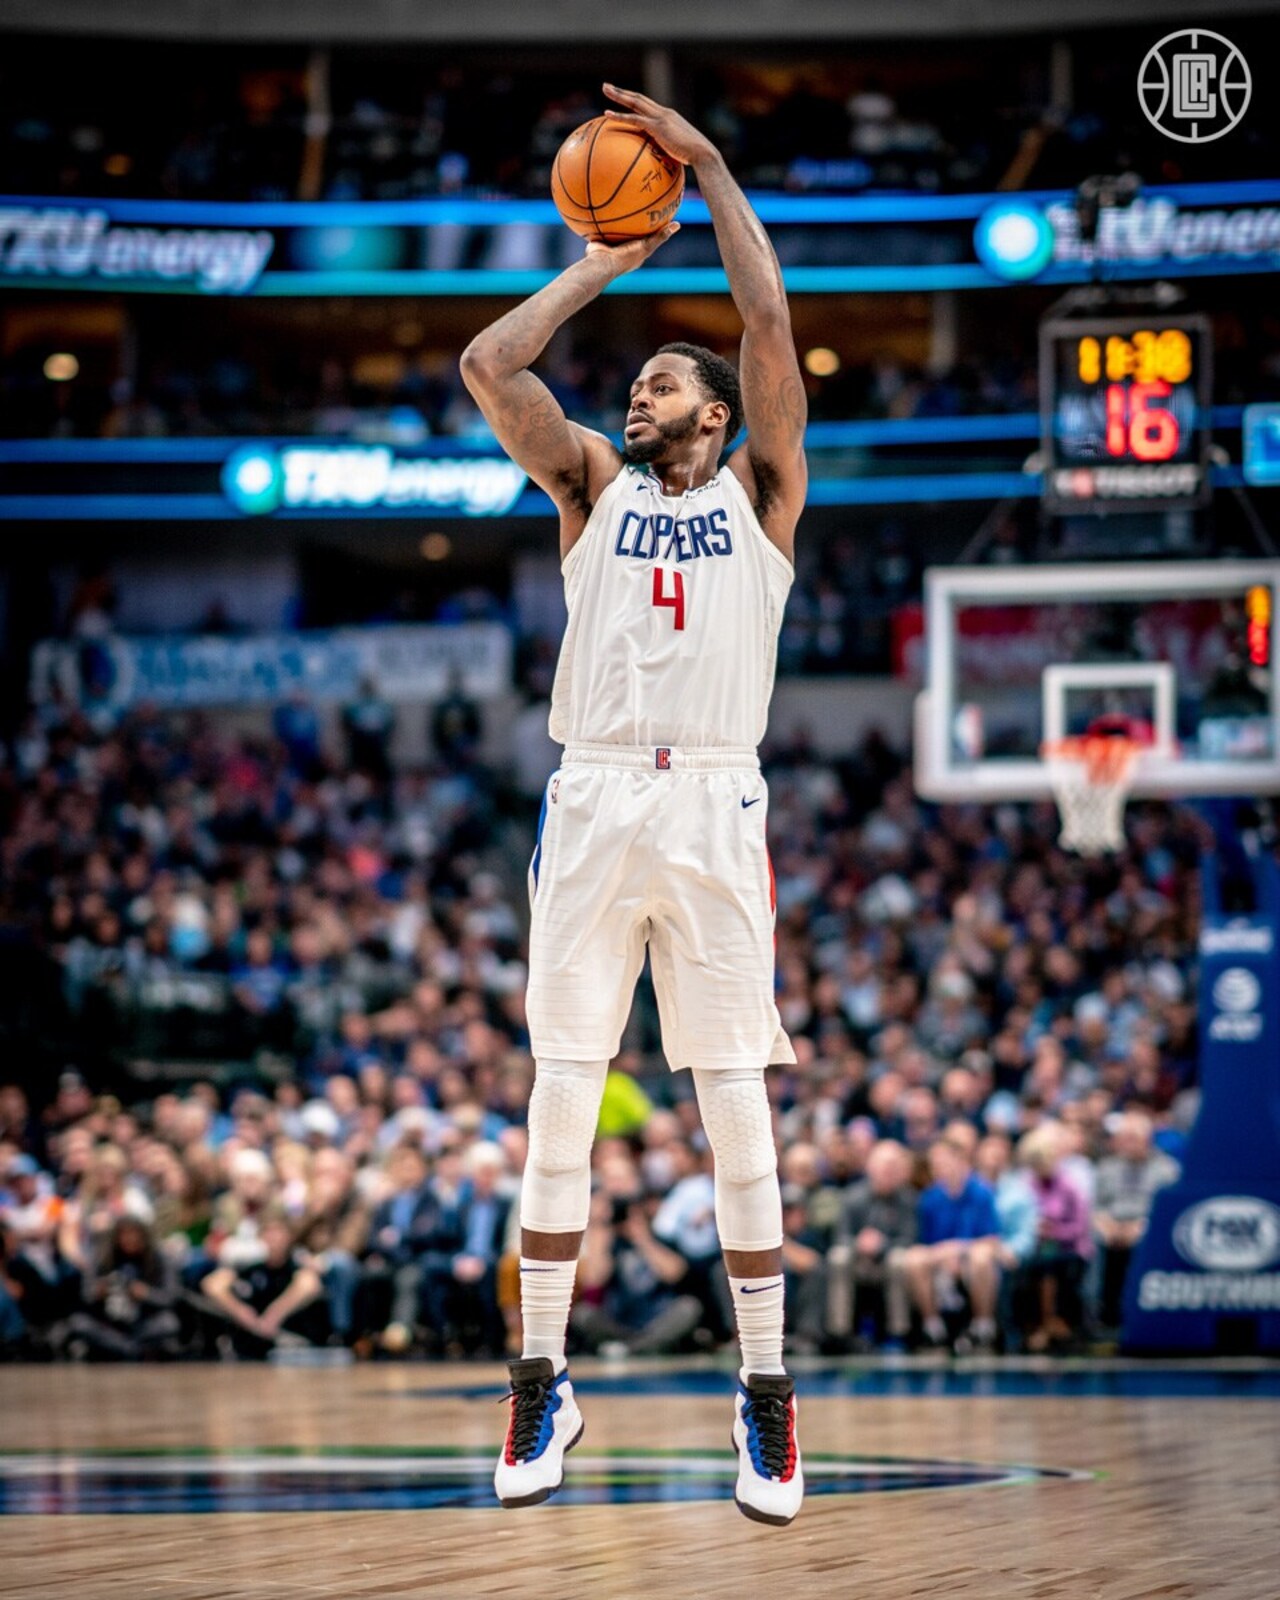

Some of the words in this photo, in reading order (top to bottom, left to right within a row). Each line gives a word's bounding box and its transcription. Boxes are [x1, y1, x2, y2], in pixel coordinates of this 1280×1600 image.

[1105, 378, 1179, 461] 16
[615, 507, 733, 563] CLIPPERS
[652, 567, 685, 631] 4
